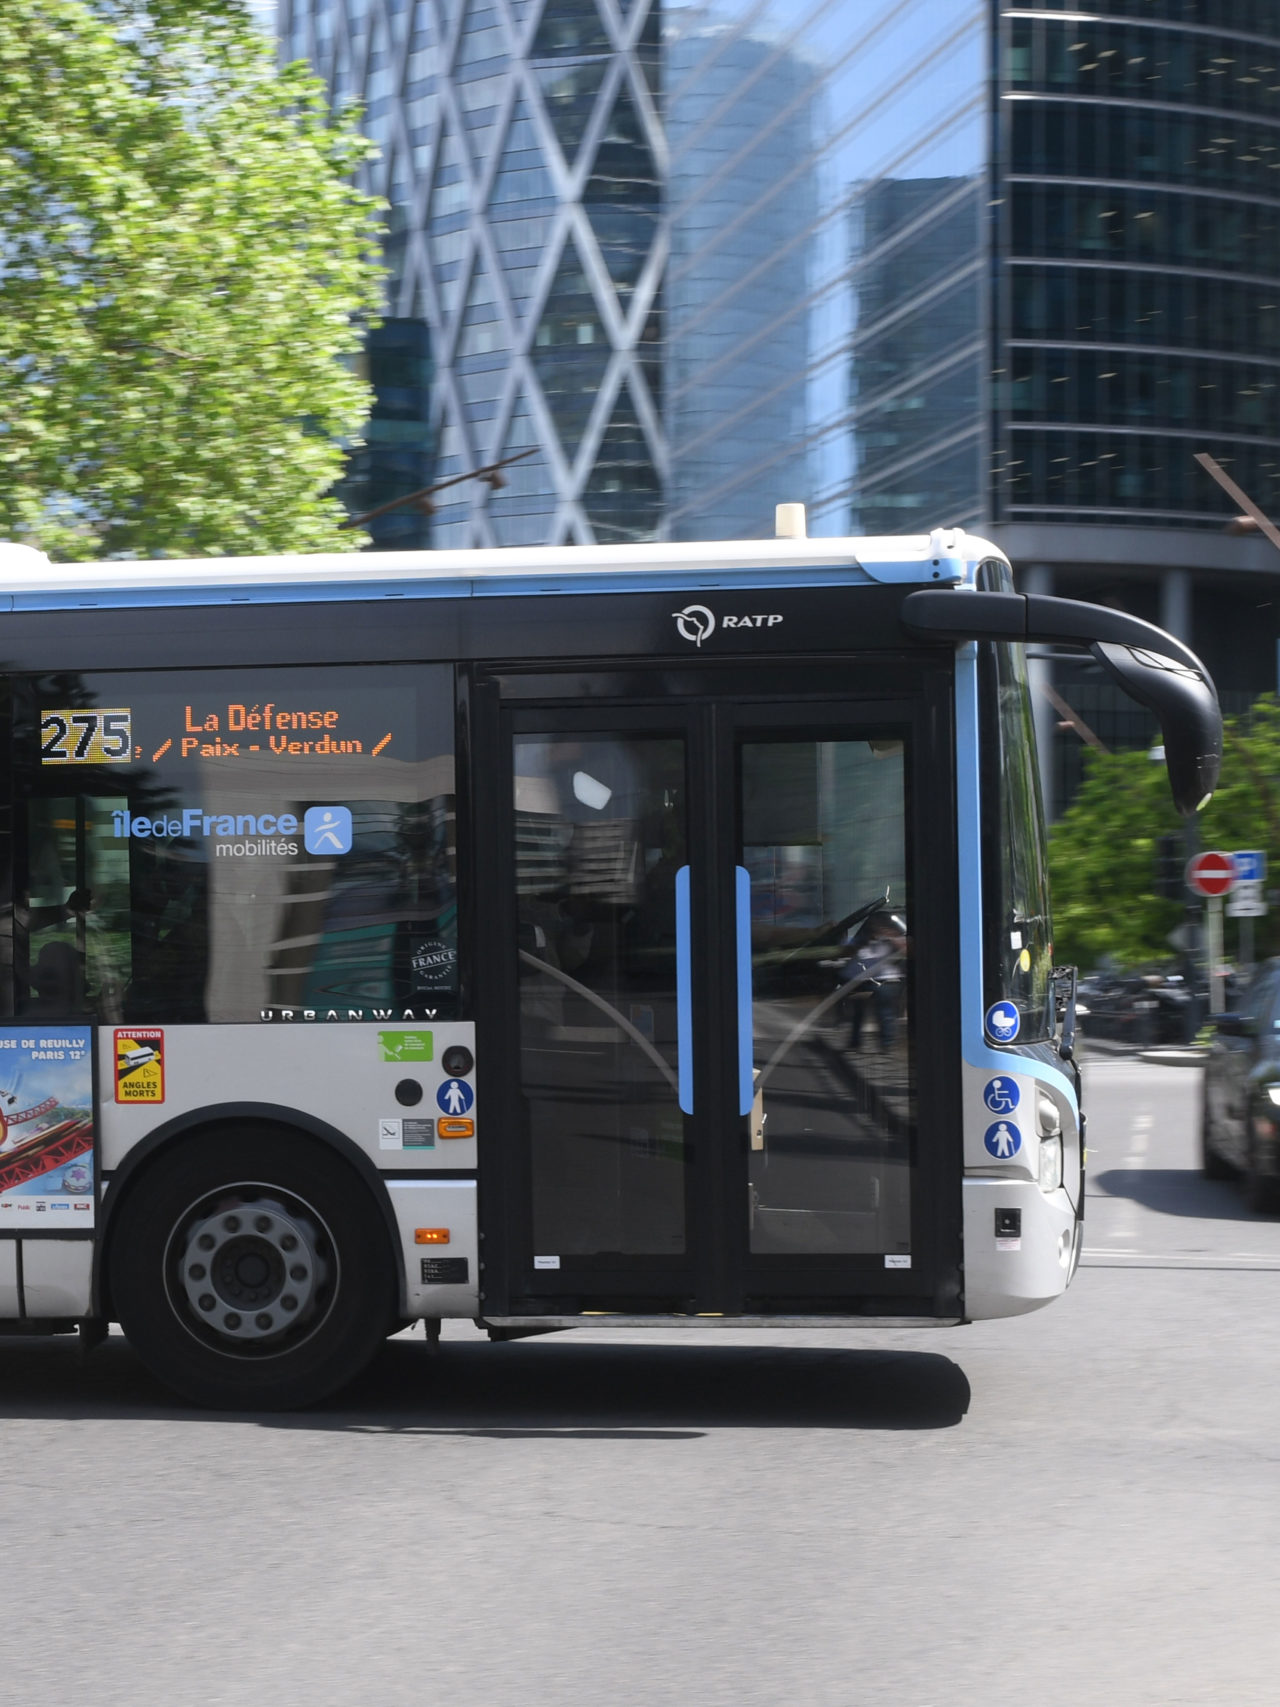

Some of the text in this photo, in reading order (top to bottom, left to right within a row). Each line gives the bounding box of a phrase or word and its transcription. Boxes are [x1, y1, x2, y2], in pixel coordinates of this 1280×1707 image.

[722, 615, 783, 628] RATP
[185, 703, 339, 732] La Défense
[41, 712, 131, 763] 275
[181, 737, 240, 757] Paix
[269, 734, 363, 755] Verdun
[216, 838, 299, 857] mobilités
[412, 951, 456, 968] FRANCE
[260, 1008, 437, 1021] URBANWAY
[21, 1040, 35, 1049] DE
[40, 1039, 85, 1048] REUILLY
[32, 1051, 65, 1060] PARIS
[122, 1081, 158, 1089] ANGLES
[124, 1089, 156, 1097] MORTS
